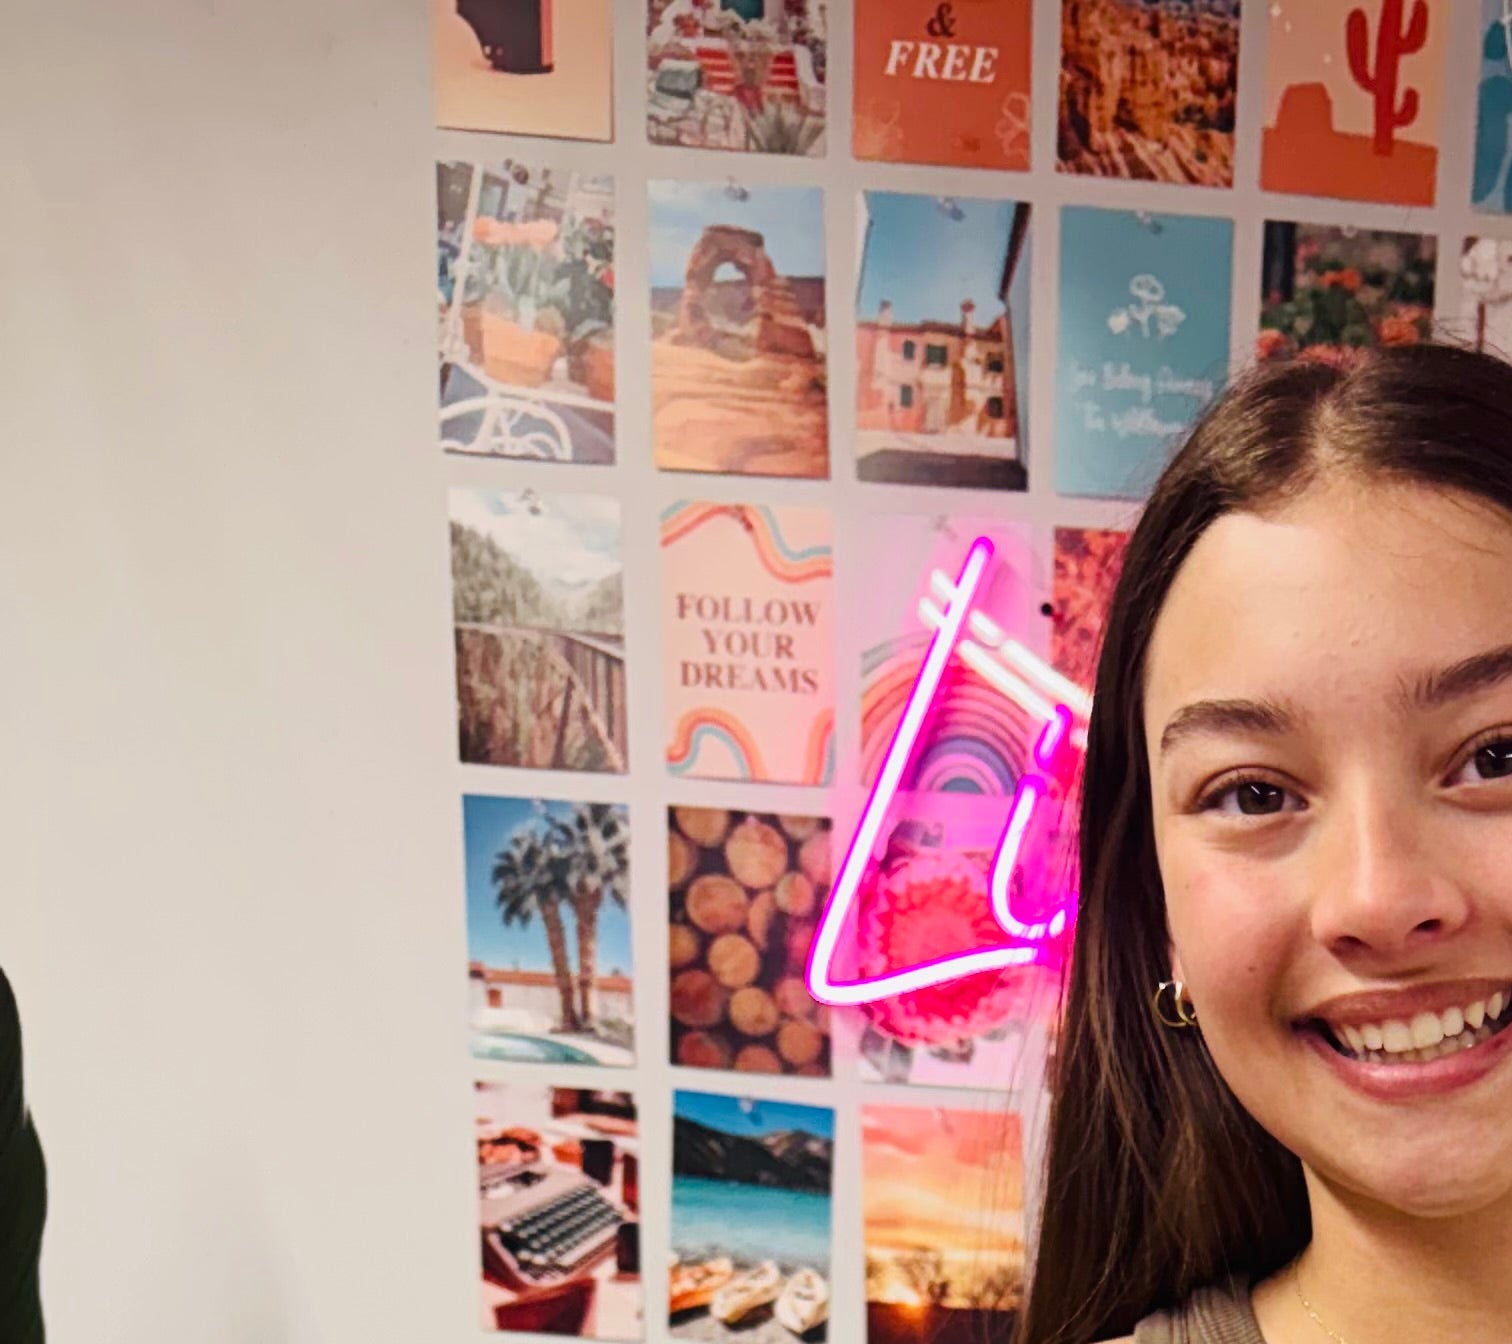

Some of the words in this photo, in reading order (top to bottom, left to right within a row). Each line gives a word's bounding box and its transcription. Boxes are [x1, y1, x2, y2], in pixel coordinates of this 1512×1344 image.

[926, 2, 957, 38] &
[883, 39, 999, 84] FREE
[675, 593, 821, 626] FOLLOW
[702, 627, 796, 660] YOUR
[679, 660, 820, 694] DREAMS
